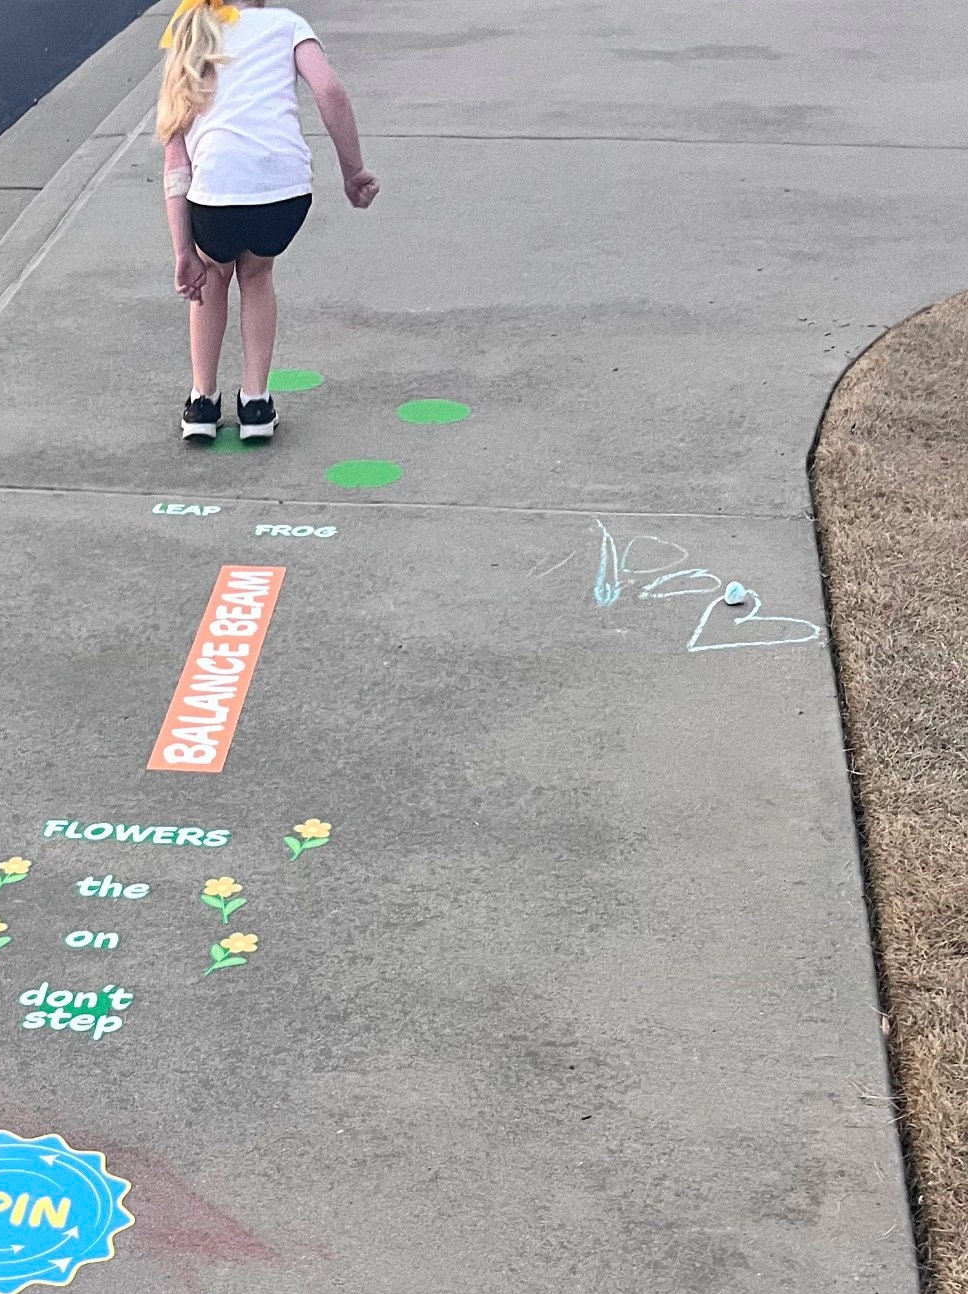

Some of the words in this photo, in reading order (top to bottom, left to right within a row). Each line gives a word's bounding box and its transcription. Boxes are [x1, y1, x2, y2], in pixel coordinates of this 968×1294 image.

[152, 503, 221, 516] LEAP
[255, 524, 337, 537] FROG
[163, 641, 250, 764] BALANCE
[209, 570, 274, 637] BEAM
[43, 820, 229, 847] FLOWERS
[76, 875, 150, 899] the
[65, 931, 119, 948] on
[21, 1009, 123, 1040] step
